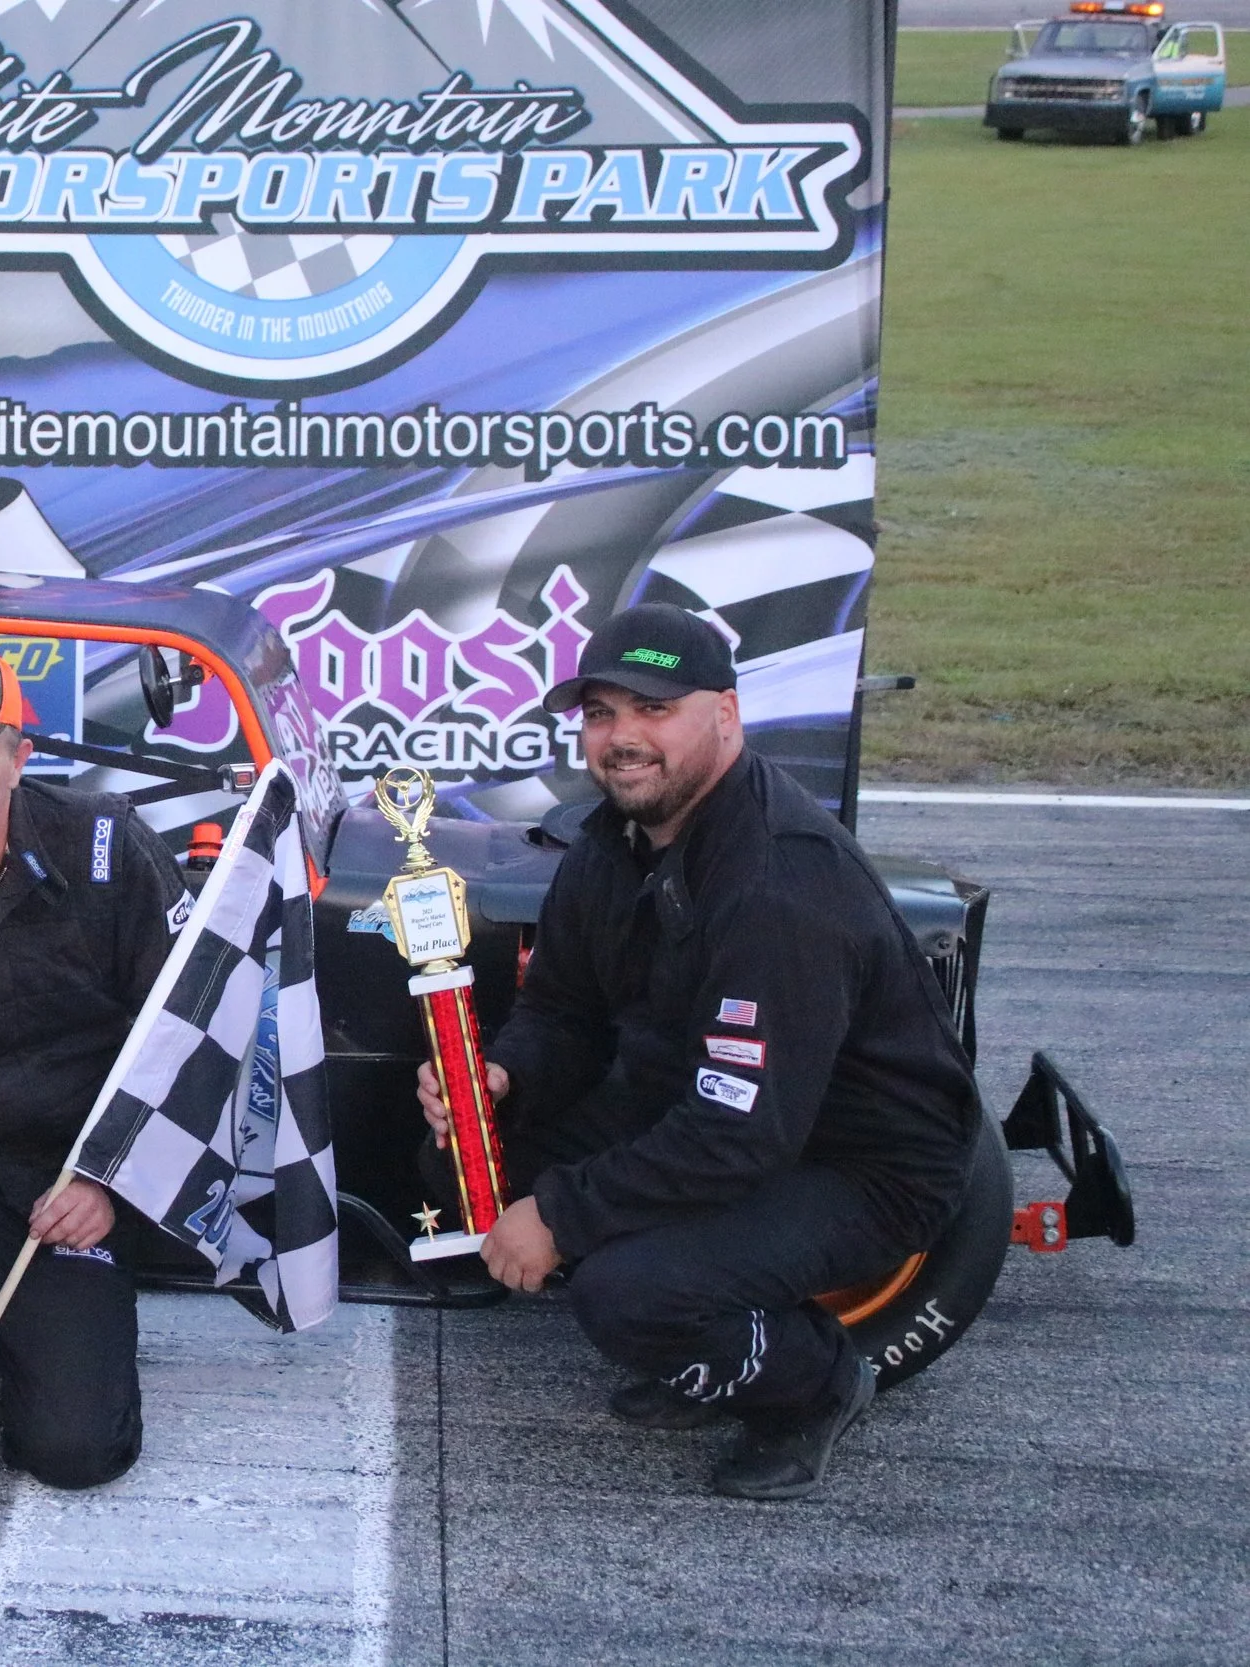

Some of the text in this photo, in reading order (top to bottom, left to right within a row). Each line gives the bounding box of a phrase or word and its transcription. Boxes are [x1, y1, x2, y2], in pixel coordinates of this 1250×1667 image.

[125, 18, 588, 162] Mountain
[502, 147, 814, 223] PARK
[160, 280, 394, 342] THUNDER IN THE MOUNTAINS
[327, 729, 542, 762] RACING
[93, 819, 111, 881] sparco
[411, 938, 458, 953] 2nd Place
[701, 1077, 717, 1091] sfi
